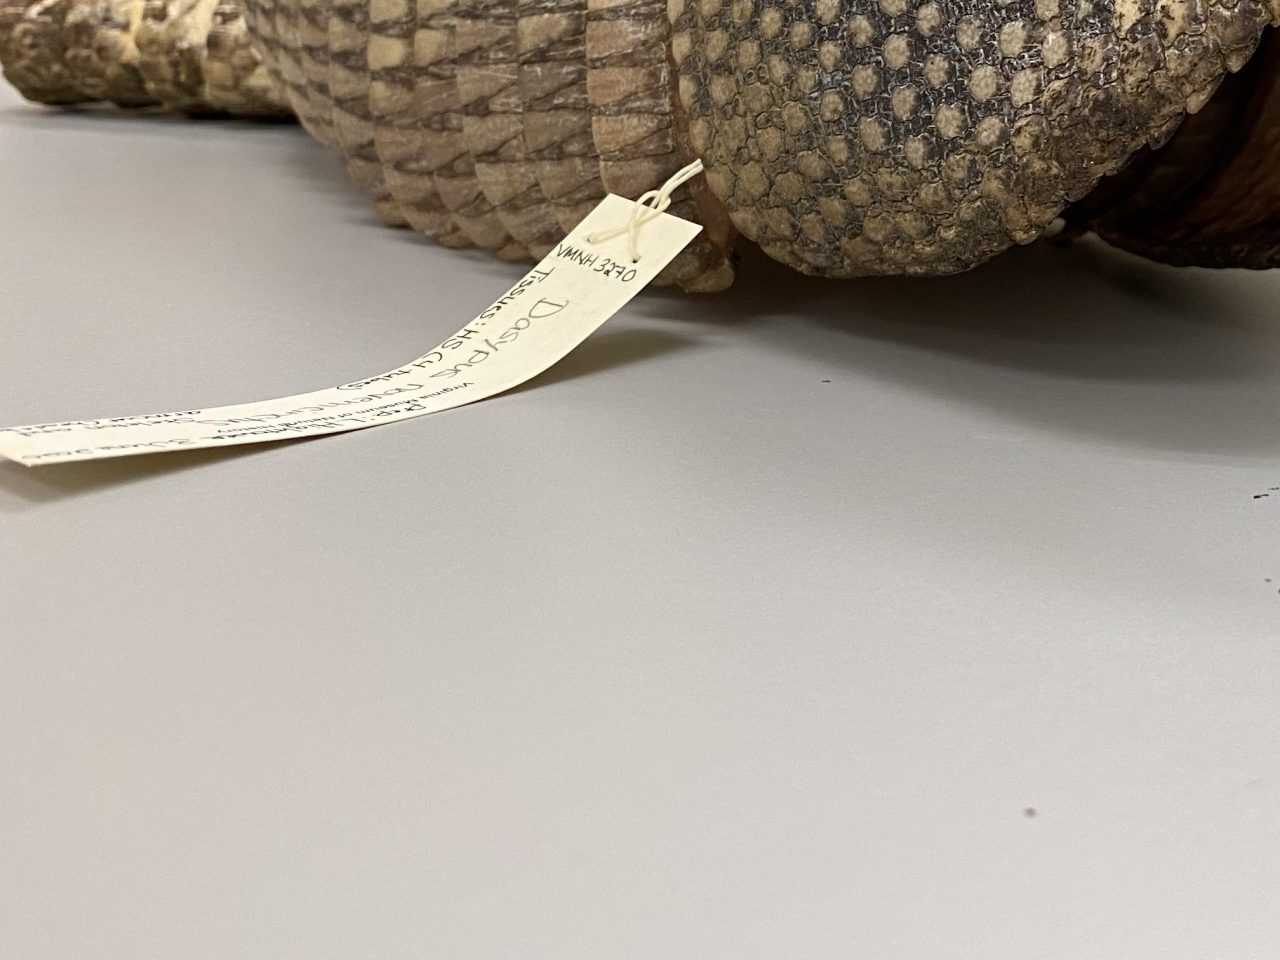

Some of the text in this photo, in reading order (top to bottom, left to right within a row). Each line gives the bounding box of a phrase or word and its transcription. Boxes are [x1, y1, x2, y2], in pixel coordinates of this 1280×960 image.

[556, 243, 637, 282] VMNH 3270
[474, 266, 556, 327] Tissues:
[441, 328, 480, 351] HS
[195, 296, 570, 426] Dasypus novemcinctus
[336, 368, 413, 391] tubes)
[418, 381, 476, 400] Virginia
[355, 398, 420, 415] Museum
